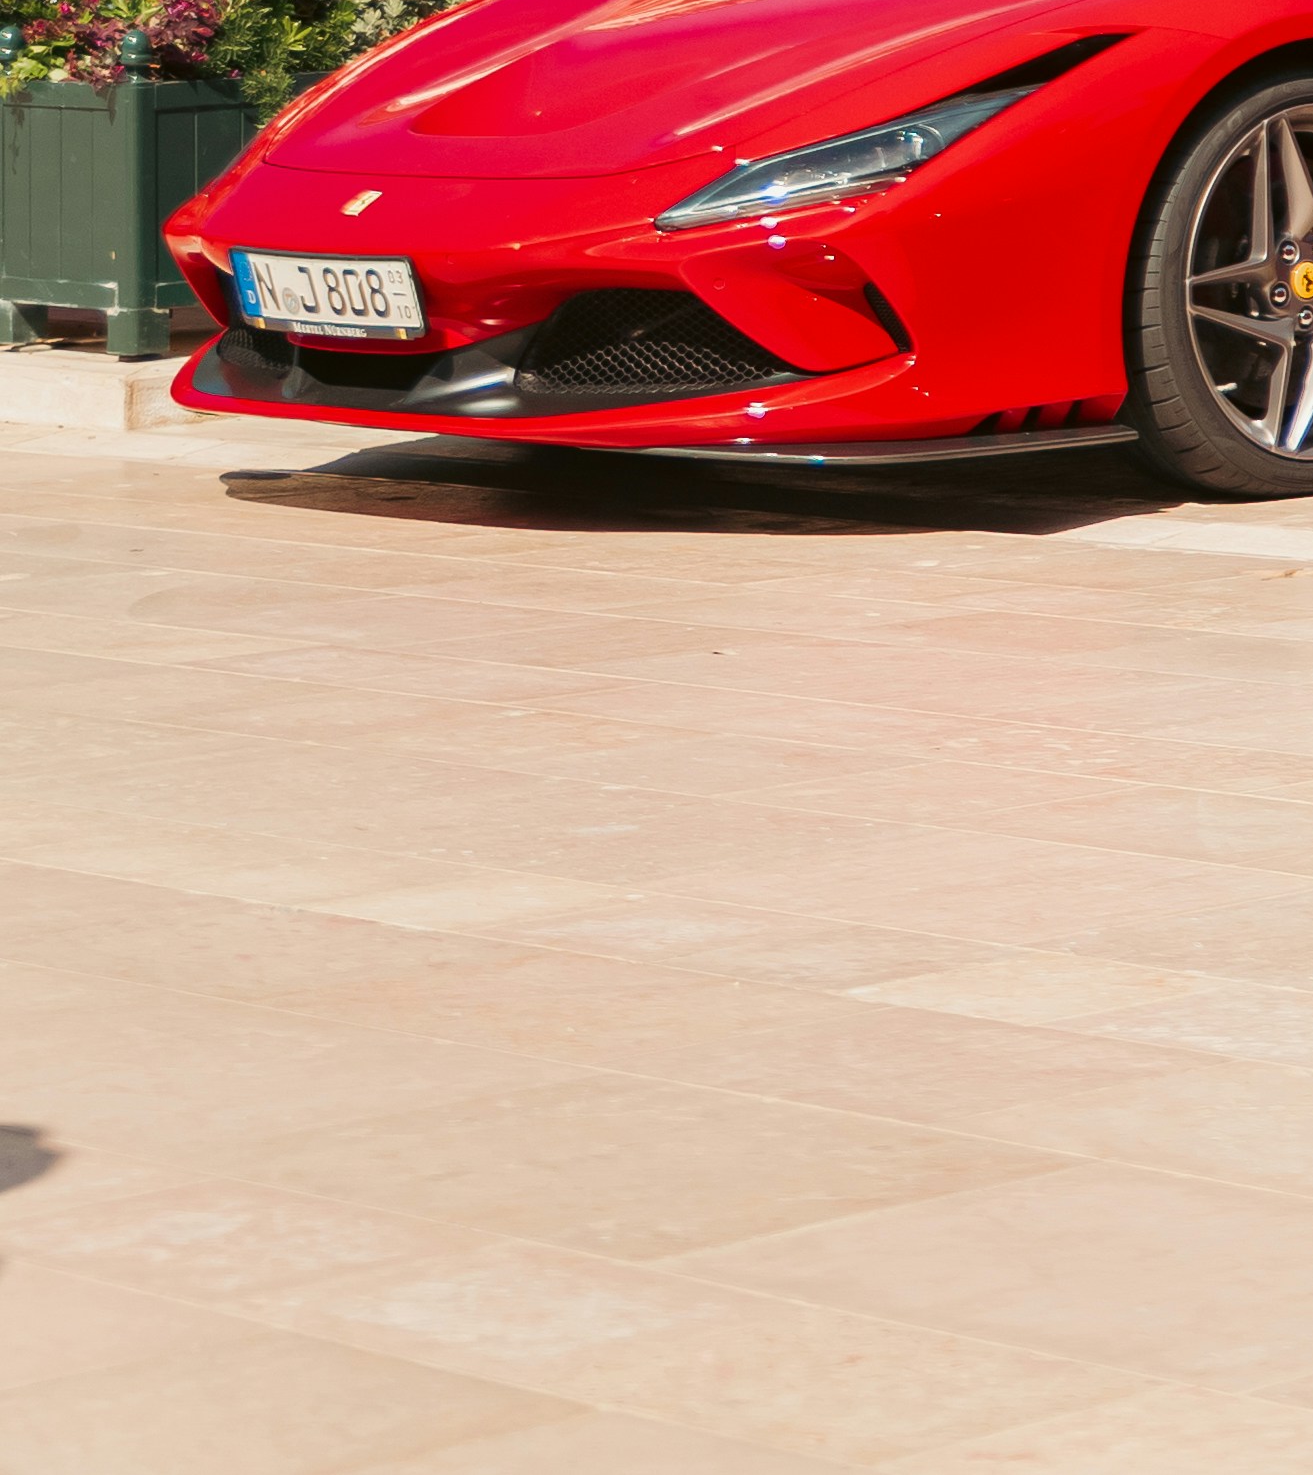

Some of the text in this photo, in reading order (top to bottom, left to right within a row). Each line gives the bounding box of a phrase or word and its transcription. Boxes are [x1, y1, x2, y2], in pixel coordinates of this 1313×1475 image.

[246, 290, 256, 304] D
[253, 261, 391, 318] N J 808
